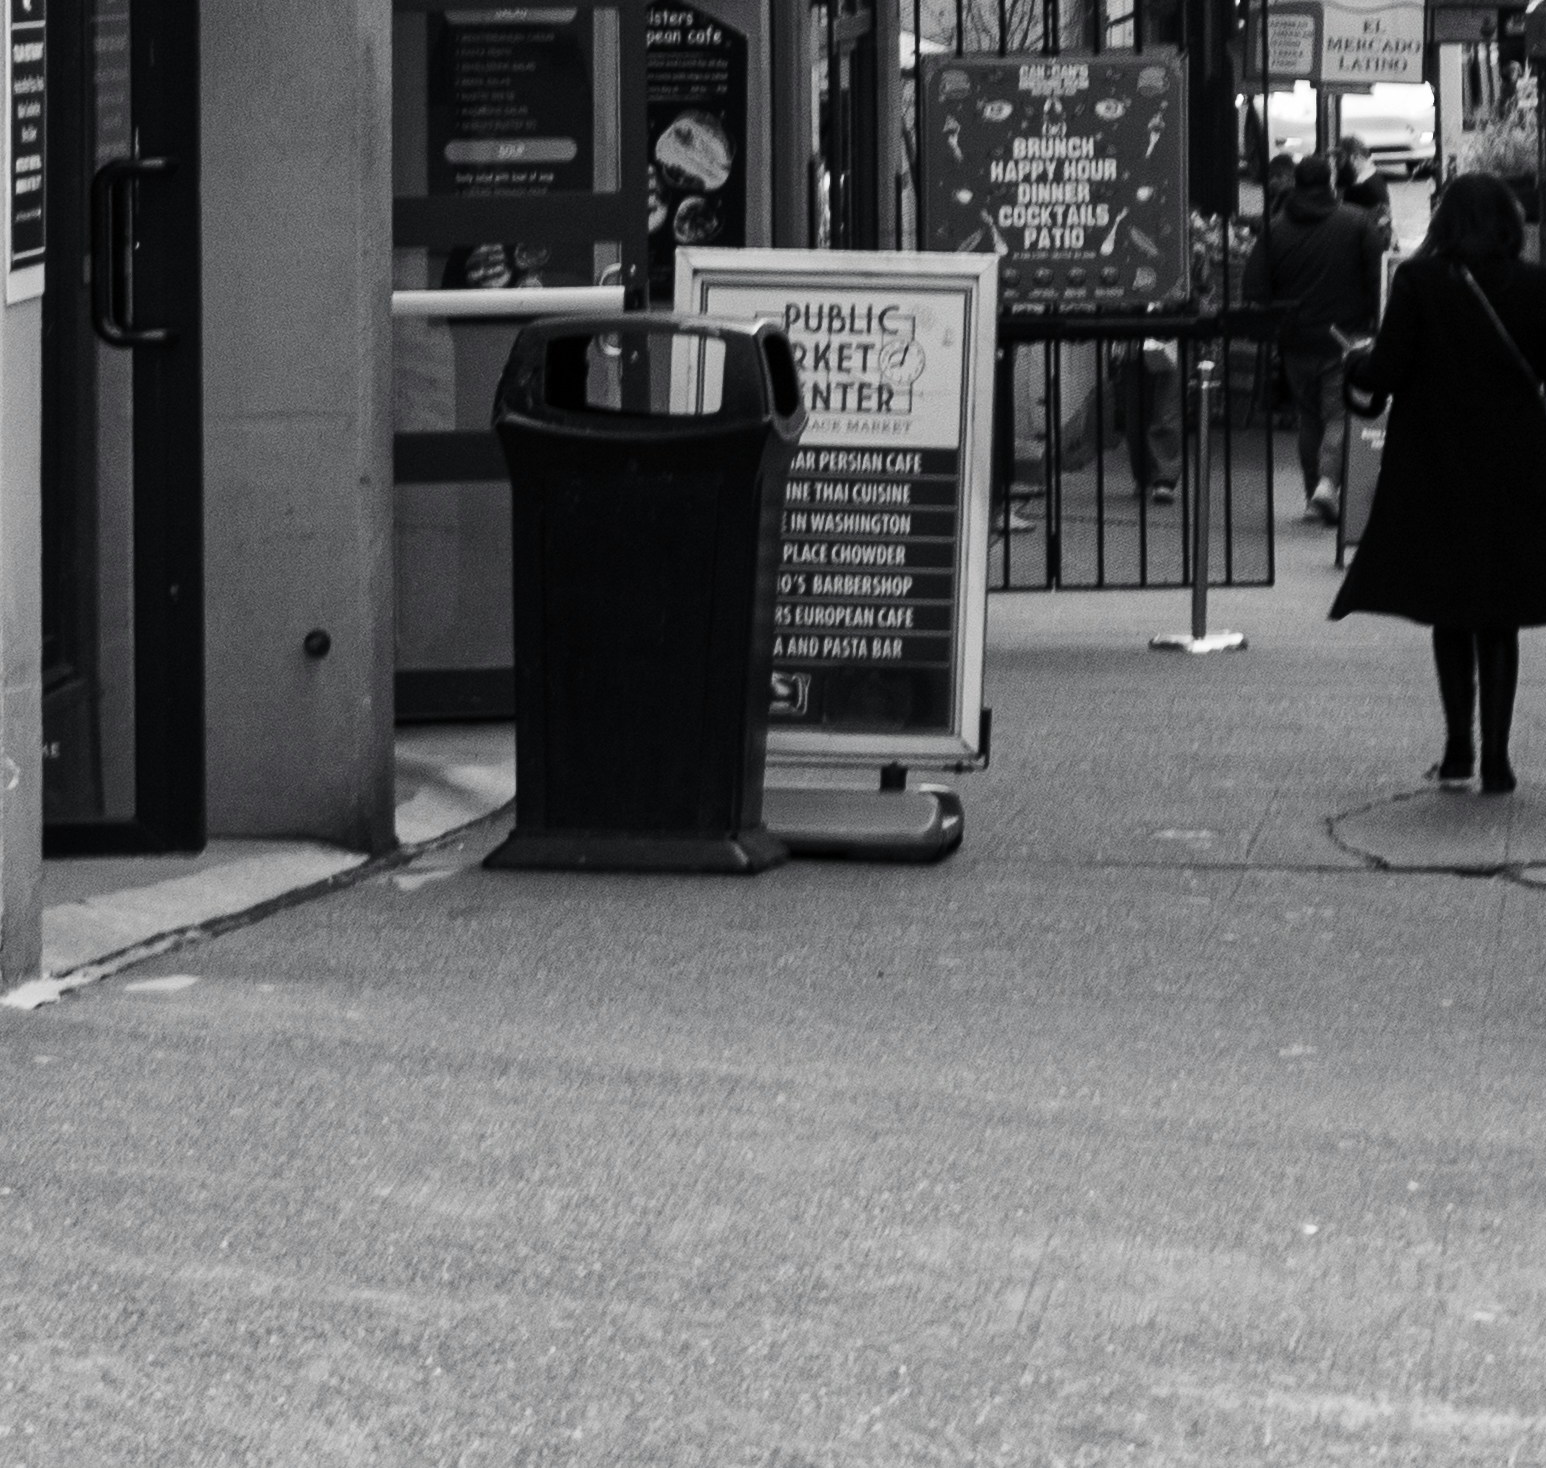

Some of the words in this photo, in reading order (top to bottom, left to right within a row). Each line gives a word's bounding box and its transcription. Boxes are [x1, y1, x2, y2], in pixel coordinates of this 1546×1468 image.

[649, 8, 694, 27] isters
[1363, 19, 1383, 34] EL
[687, 23, 722, 45] cafe
[1327, 37, 1422, 54] MERCADO
[1338, 56, 1409, 72] LATINO
[1013, 137, 1095, 160] BRUNCH
[990, 160, 1057, 183] HAPPY
[1063, 158, 1117, 181] HOUR
[1017, 182, 1091, 204] DINNER
[998, 204, 1110, 227] COCKTAILS
[1024, 227, 1085, 250] PATIO
[784, 302, 901, 336] PUBLIC
[791, 342, 876, 375] RKET
[801, 382, 895, 413] NTER
[847, 420, 913, 434] MARKET
[819, 451, 883, 473] PERSIAN
[886, 452, 923, 475] CAFE
[815, 482, 849, 504] THAI
[852, 483, 912, 506] CUISINE
[791, 513, 807, 532] IN
[811, 513, 912, 535] WASHINGTON
[783, 543, 828, 564] PLACE
[832, 544, 906, 566] CHOWDER
[812, 574, 913, 597] BARBERSHOP
[795, 606, 875, 628] EUROPEAN
[878, 607, 915, 629] CAFE
[787, 636, 819, 657] AND
[823, 636, 868, 660] PASTA
[872, 637, 903, 660] BAR
